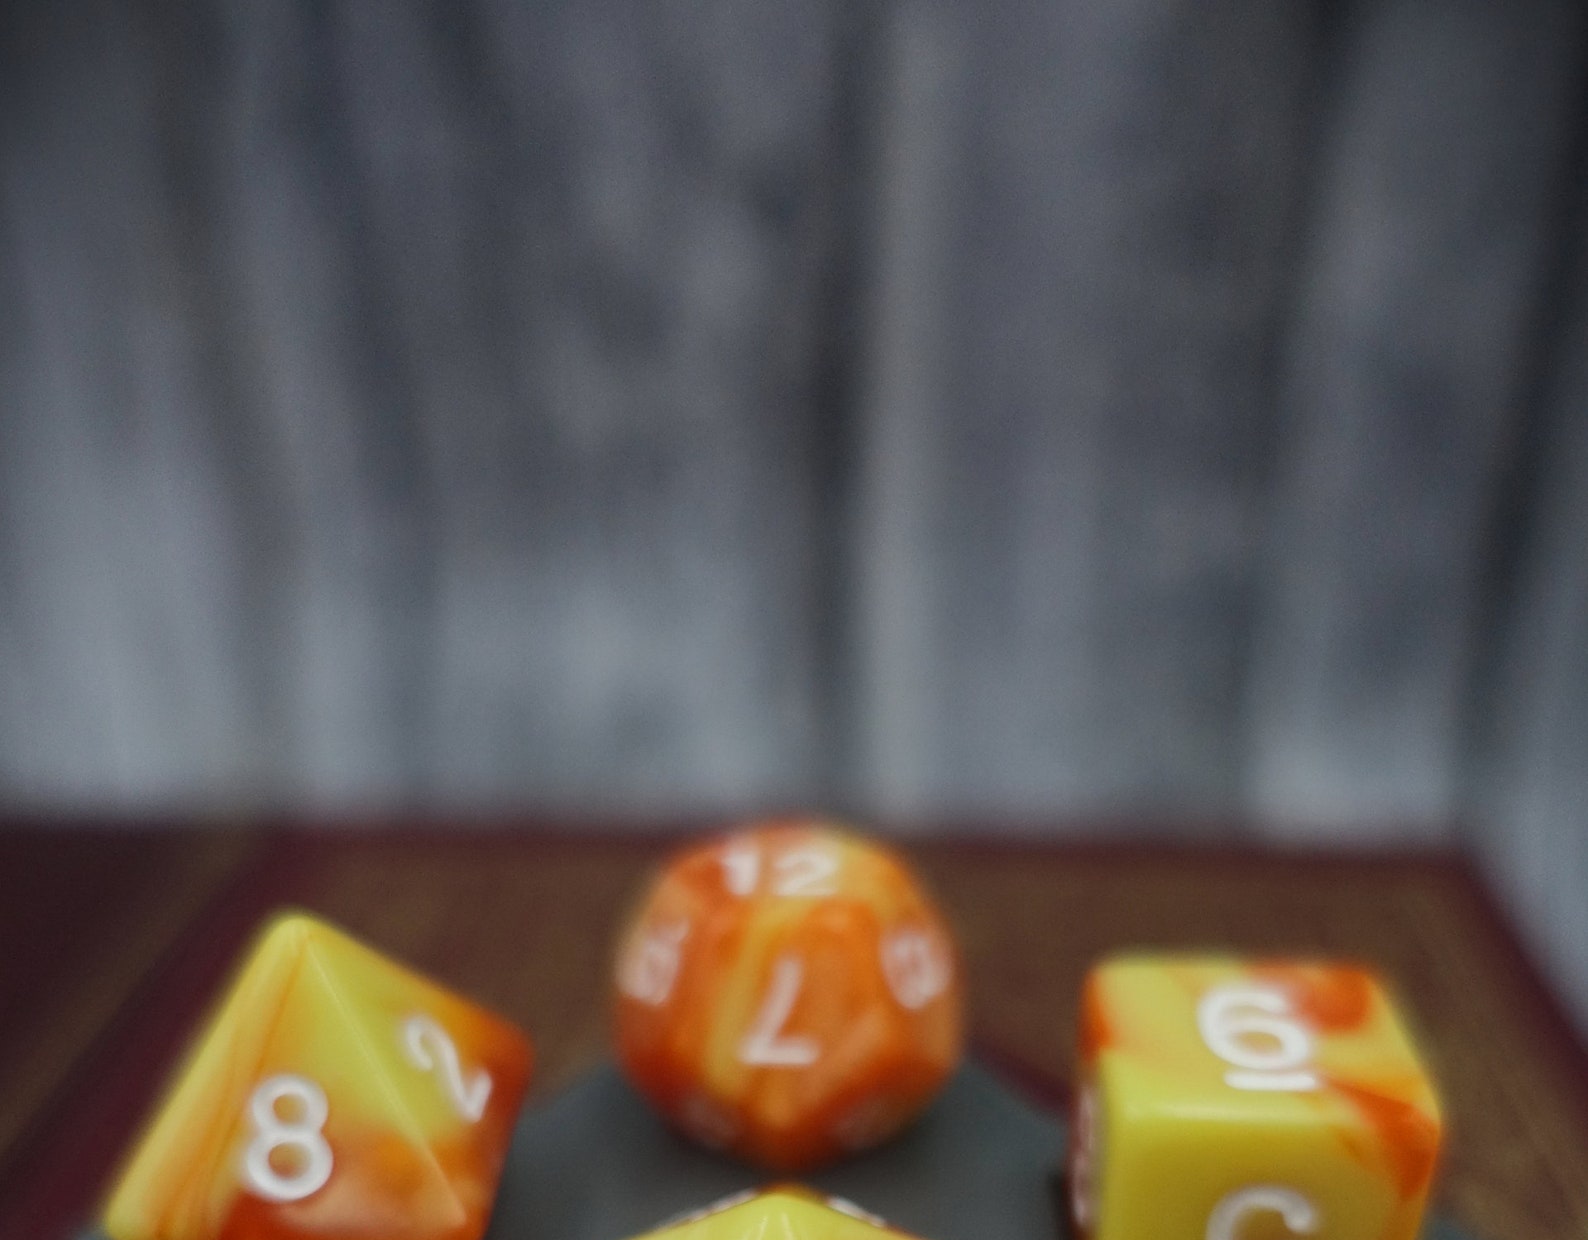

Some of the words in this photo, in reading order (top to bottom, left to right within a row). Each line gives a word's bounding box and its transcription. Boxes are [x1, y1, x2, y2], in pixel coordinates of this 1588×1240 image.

[722, 836, 842, 897] 12
[736, 952, 821, 1066] 7
[1198, 981, 1320, 1091] 6
[397, 1012, 493, 1124] 2
[246, 1073, 334, 1201] 8
